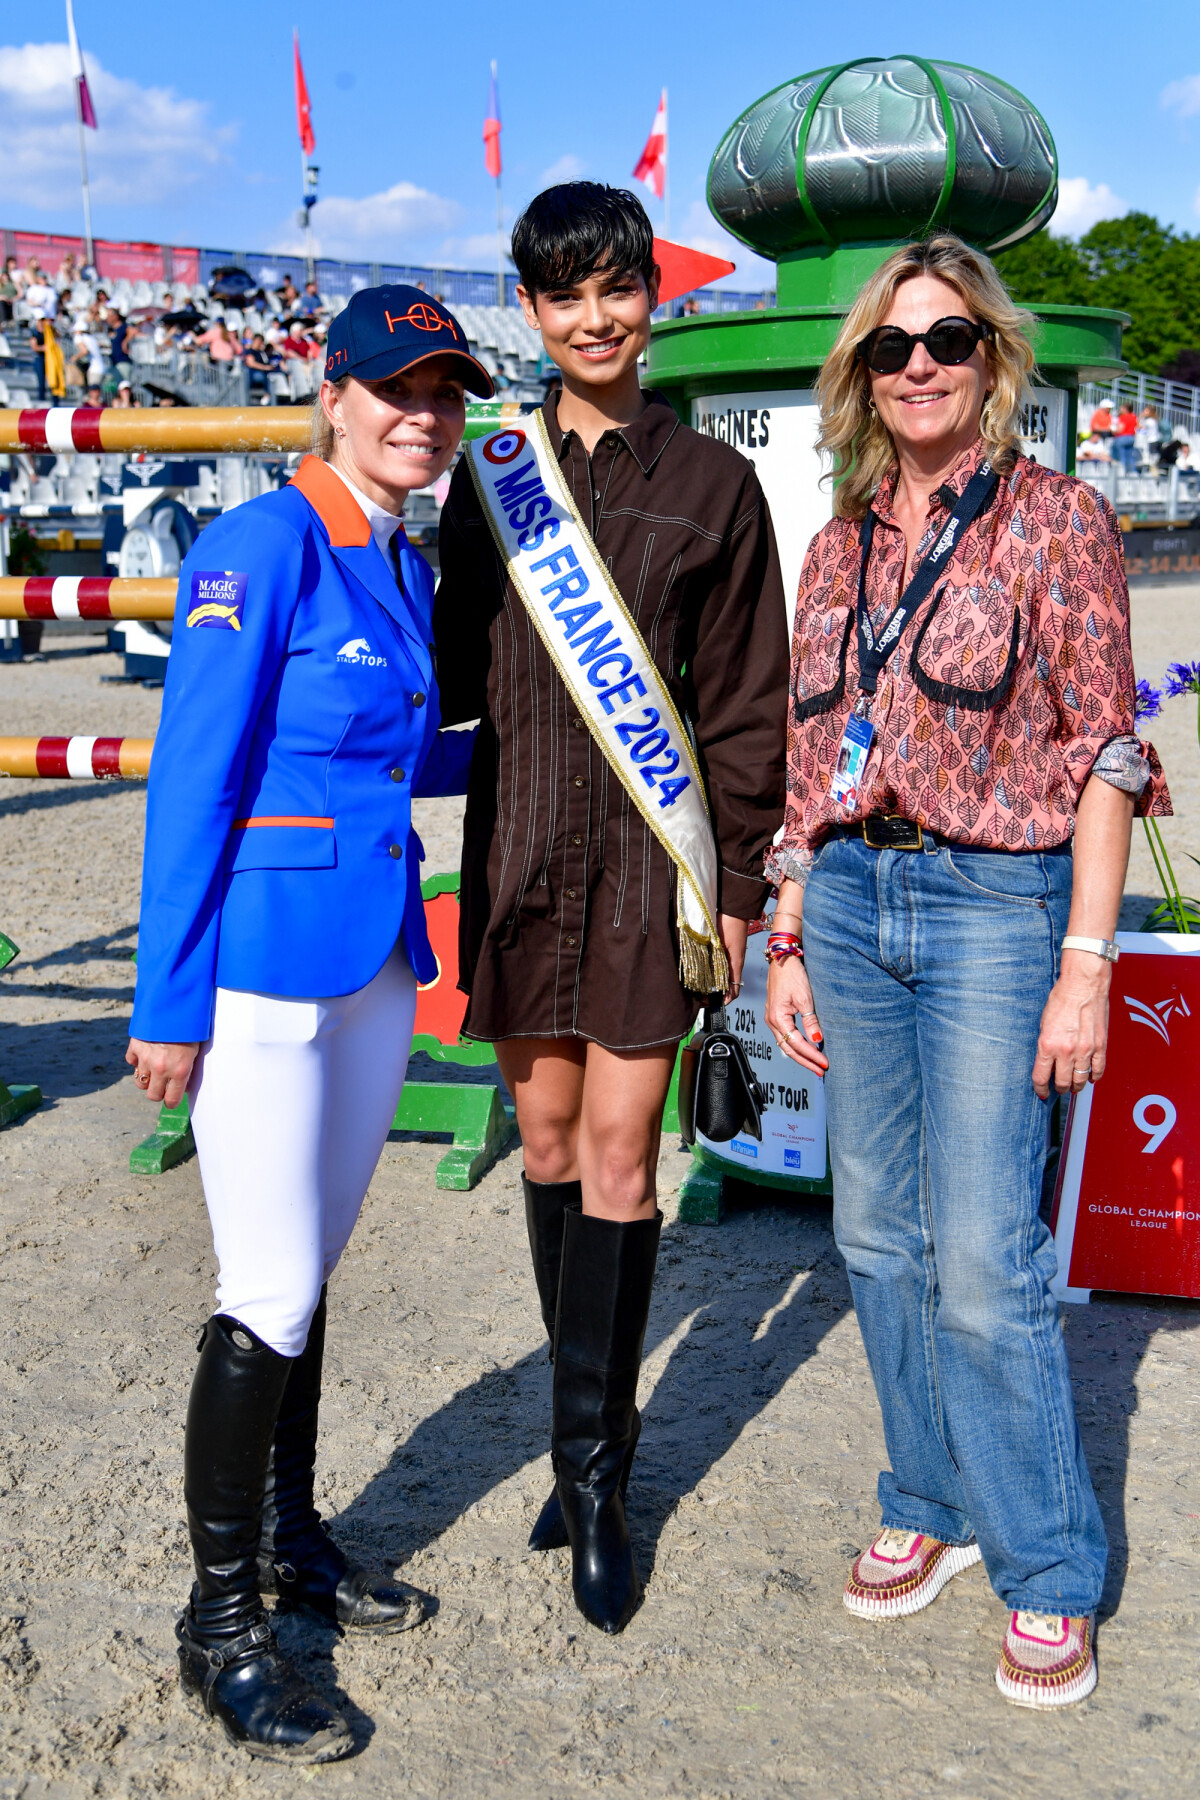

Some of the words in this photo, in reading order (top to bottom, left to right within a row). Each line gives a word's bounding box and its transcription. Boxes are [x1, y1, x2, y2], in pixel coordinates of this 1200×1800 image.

[929, 517, 960, 563] LONGINES
[197, 591, 237, 601] MILLIONS
[198, 579, 238, 593] MAGIC
[494, 459, 561, 552] MISS
[529, 543, 648, 716] FRANCE
[613, 706, 692, 809] 2024
[875, 608, 907, 653] LONGINES
[336, 656, 351, 664] STAL
[361, 655, 388, 668] TOPS
[734, 1007, 757, 1034] 2024
[777, 1085, 809, 1112] TOUR
[1132, 1093, 1177, 1154] 9
[1088, 1204, 1135, 1216] GLOBAL
[1130, 1220, 1168, 1230] LEAGUE
